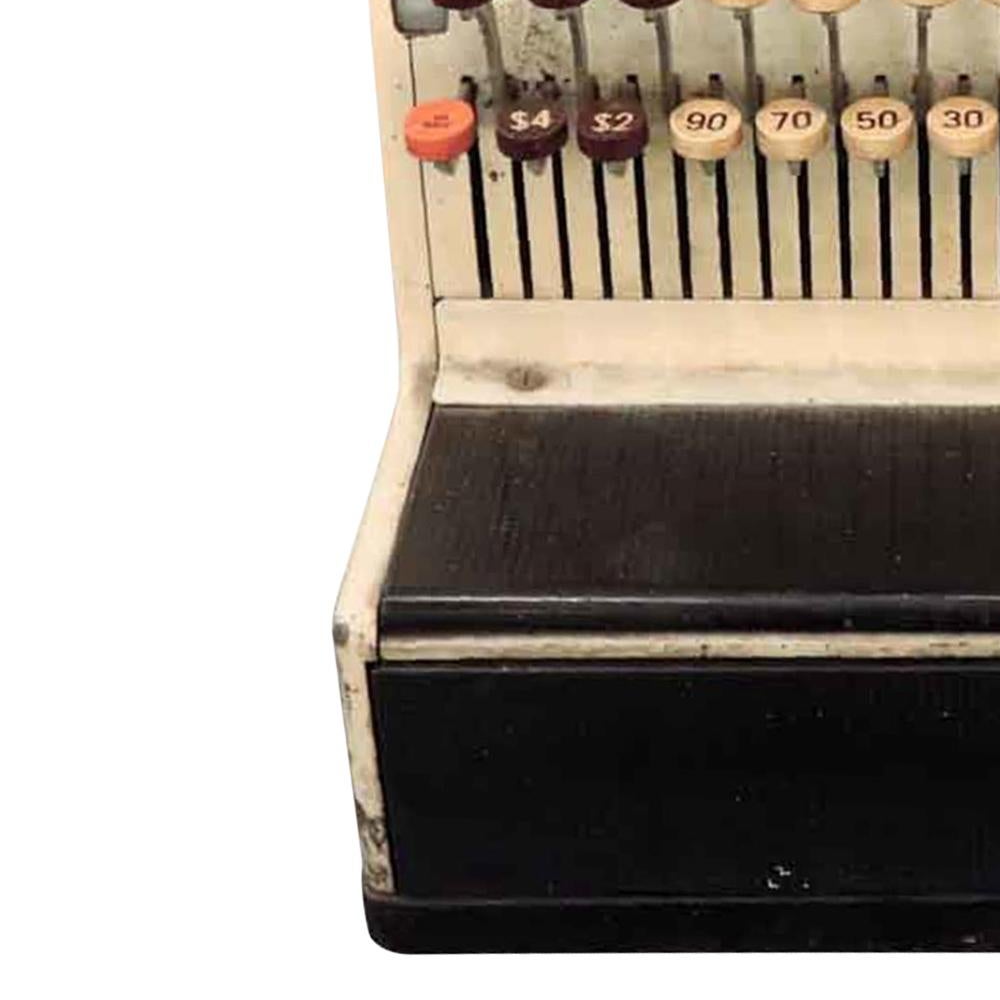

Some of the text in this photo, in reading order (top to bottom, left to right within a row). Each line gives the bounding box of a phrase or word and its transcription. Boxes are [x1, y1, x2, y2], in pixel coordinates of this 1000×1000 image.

[510, 110, 552, 131] $4
[592, 112, 635, 131] $2
[686, 112, 727, 131] 90
[770, 109, 813, 131] 70
[856, 110, 898, 130] 50
[943, 110, 983, 128] 30
